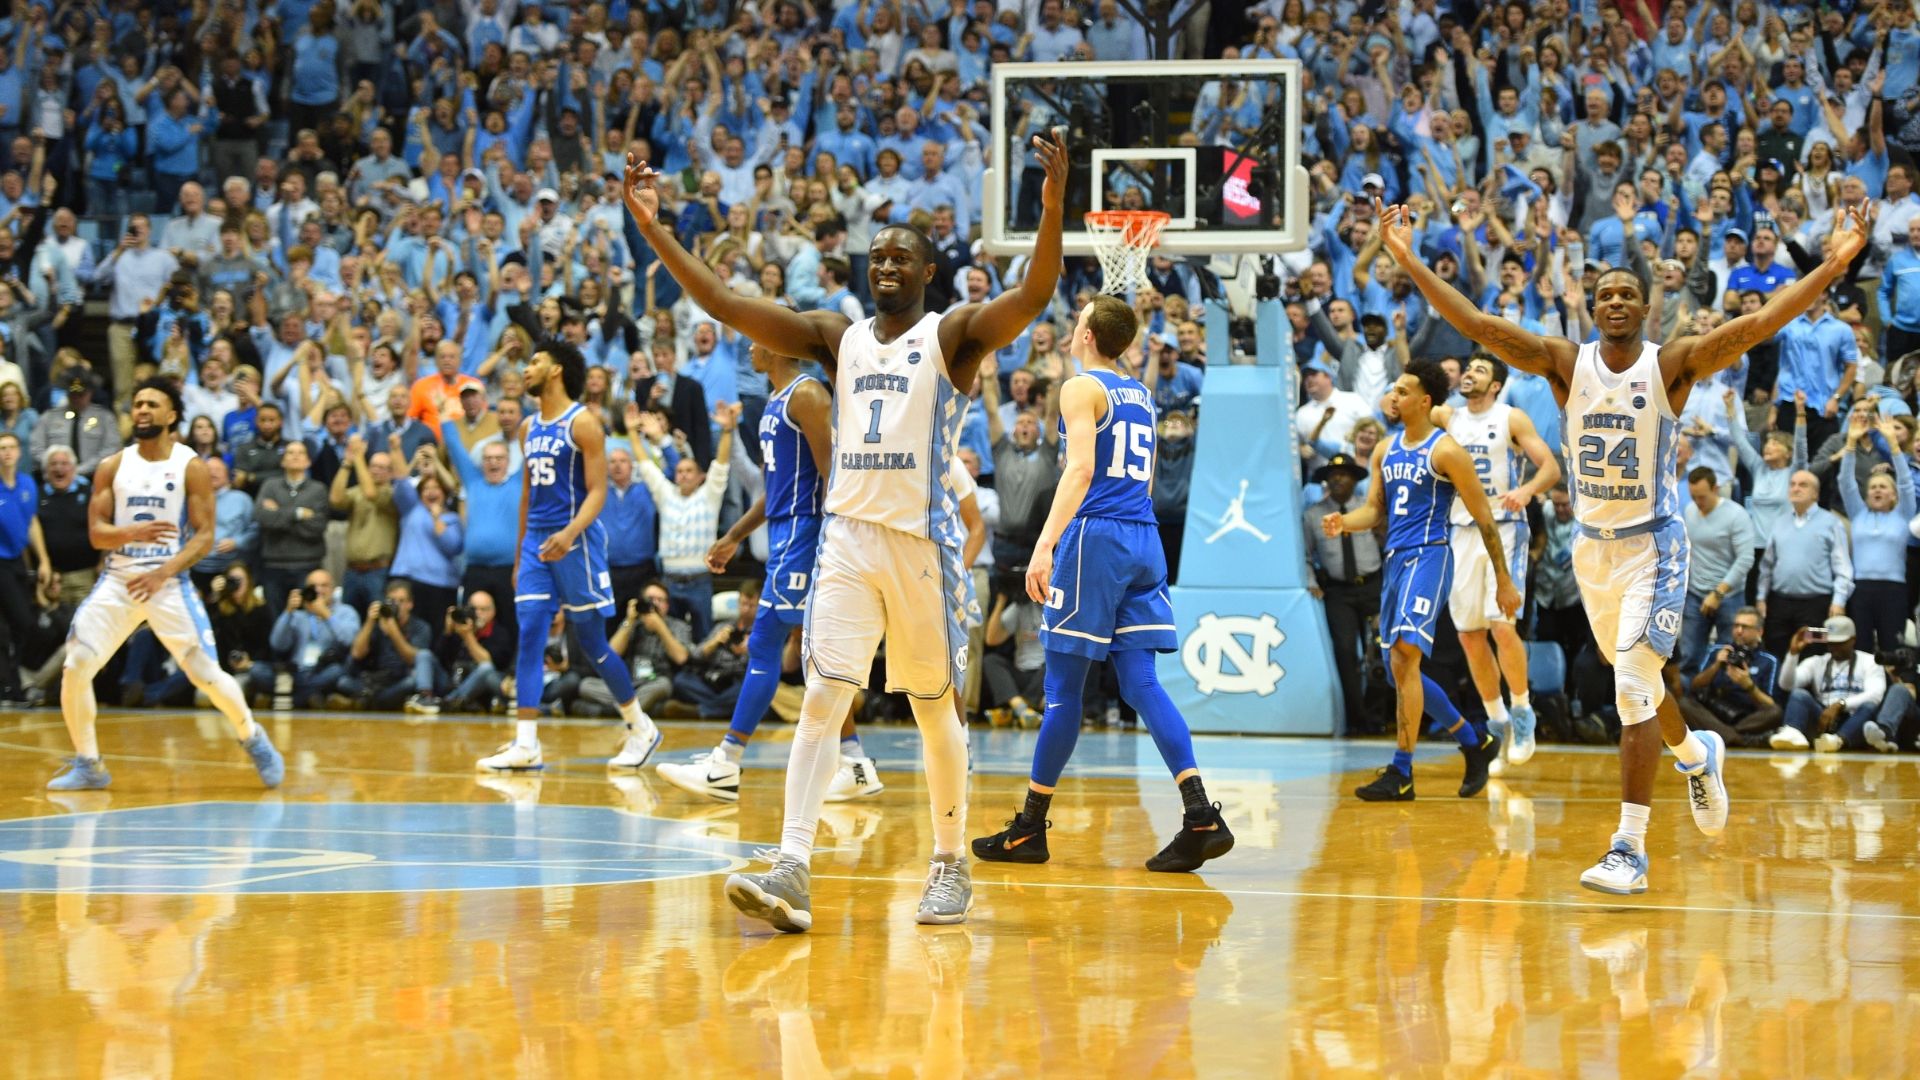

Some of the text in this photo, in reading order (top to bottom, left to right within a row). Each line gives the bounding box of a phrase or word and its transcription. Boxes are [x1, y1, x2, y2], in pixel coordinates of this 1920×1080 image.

[853, 374, 909, 394] NORTH
[864, 399, 883, 443] 1
[1583, 414, 1635, 432] NORTH
[524, 435, 565, 458] DUKE
[1107, 420, 1152, 482] 15
[1579, 434, 1640, 479] 24
[527, 456, 556, 487] 35
[841, 452, 916, 470] CAROLINA
[1383, 462, 1427, 485] DUKE
[1577, 479, 1647, 500] CAROLINA
[127, 495, 166, 509] NORTH
[1394, 485, 1409, 516] 2
[115, 545, 172, 558] AROLINA
[787, 572, 807, 591] D
[1412, 596, 1431, 616] D
